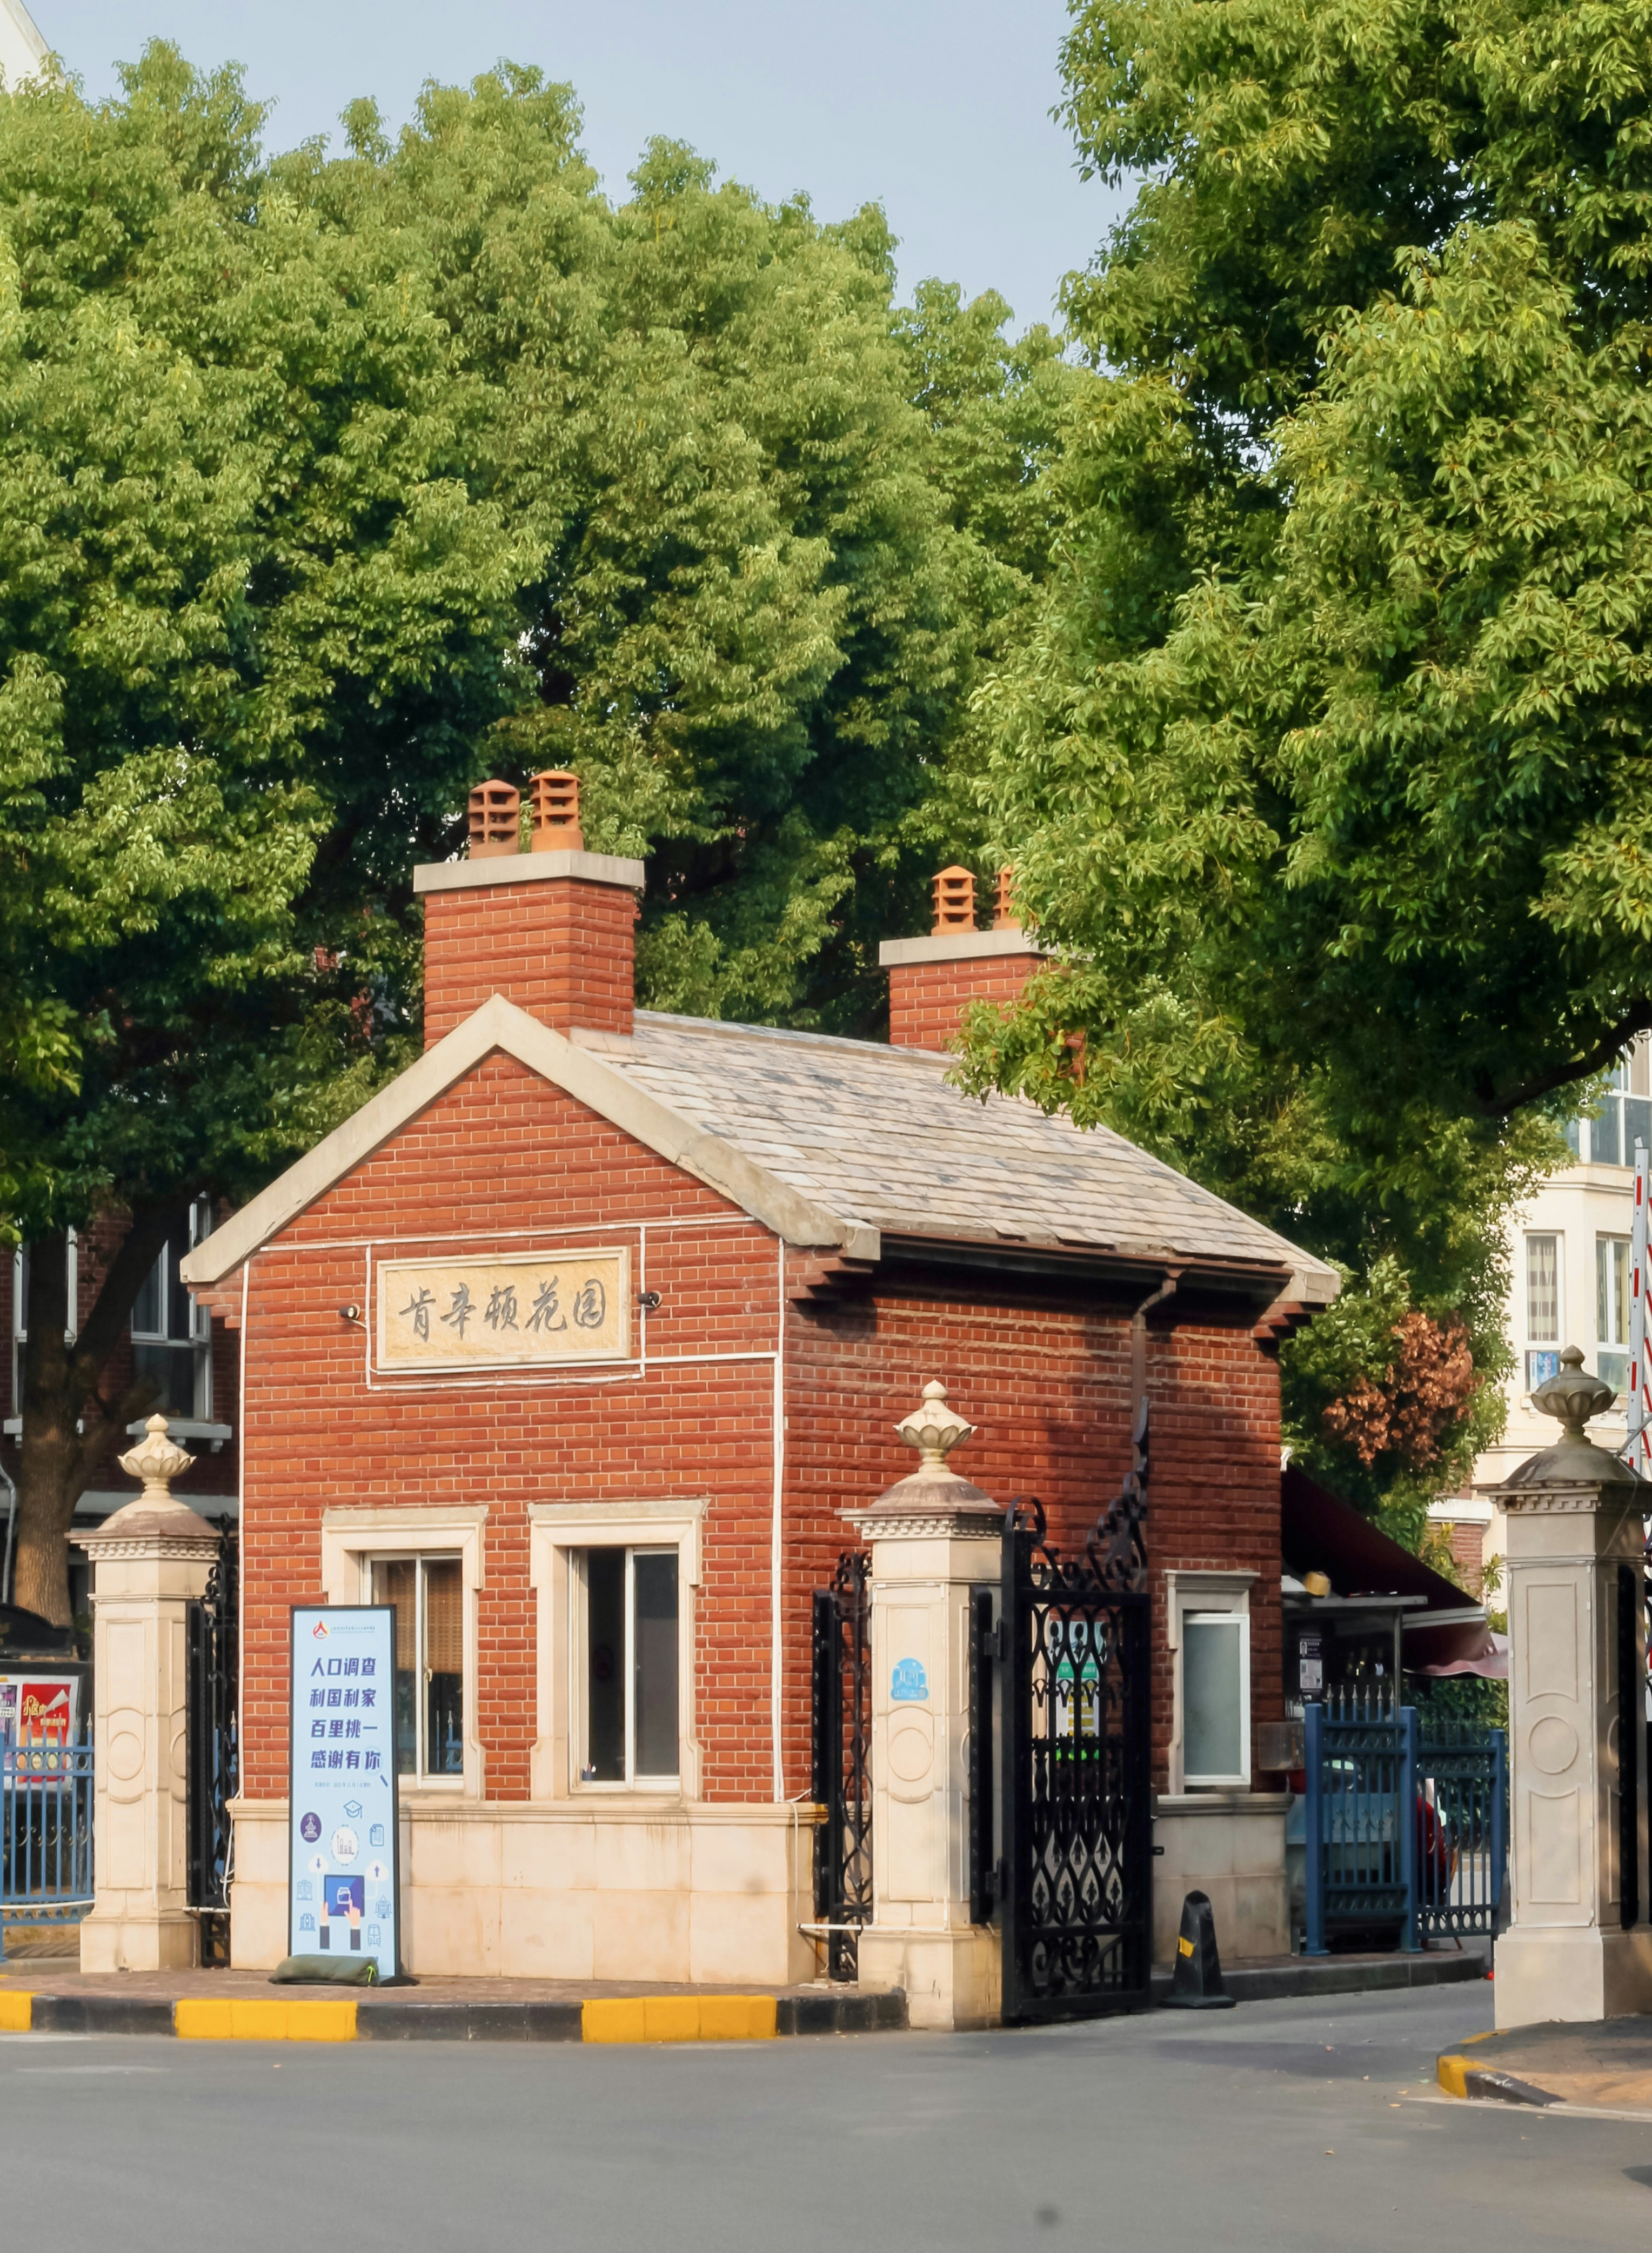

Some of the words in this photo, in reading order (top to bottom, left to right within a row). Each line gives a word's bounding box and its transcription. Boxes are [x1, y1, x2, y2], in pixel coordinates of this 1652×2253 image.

[399, 1275, 606, 1343] 肯辛顿花园
[310, 1657, 377, 1676] 人口调查
[310, 1688, 377, 1707] 利国利家
[311, 1719, 378, 1738] 百里挑一
[311, 1750, 381, 1770] 感谢有你
